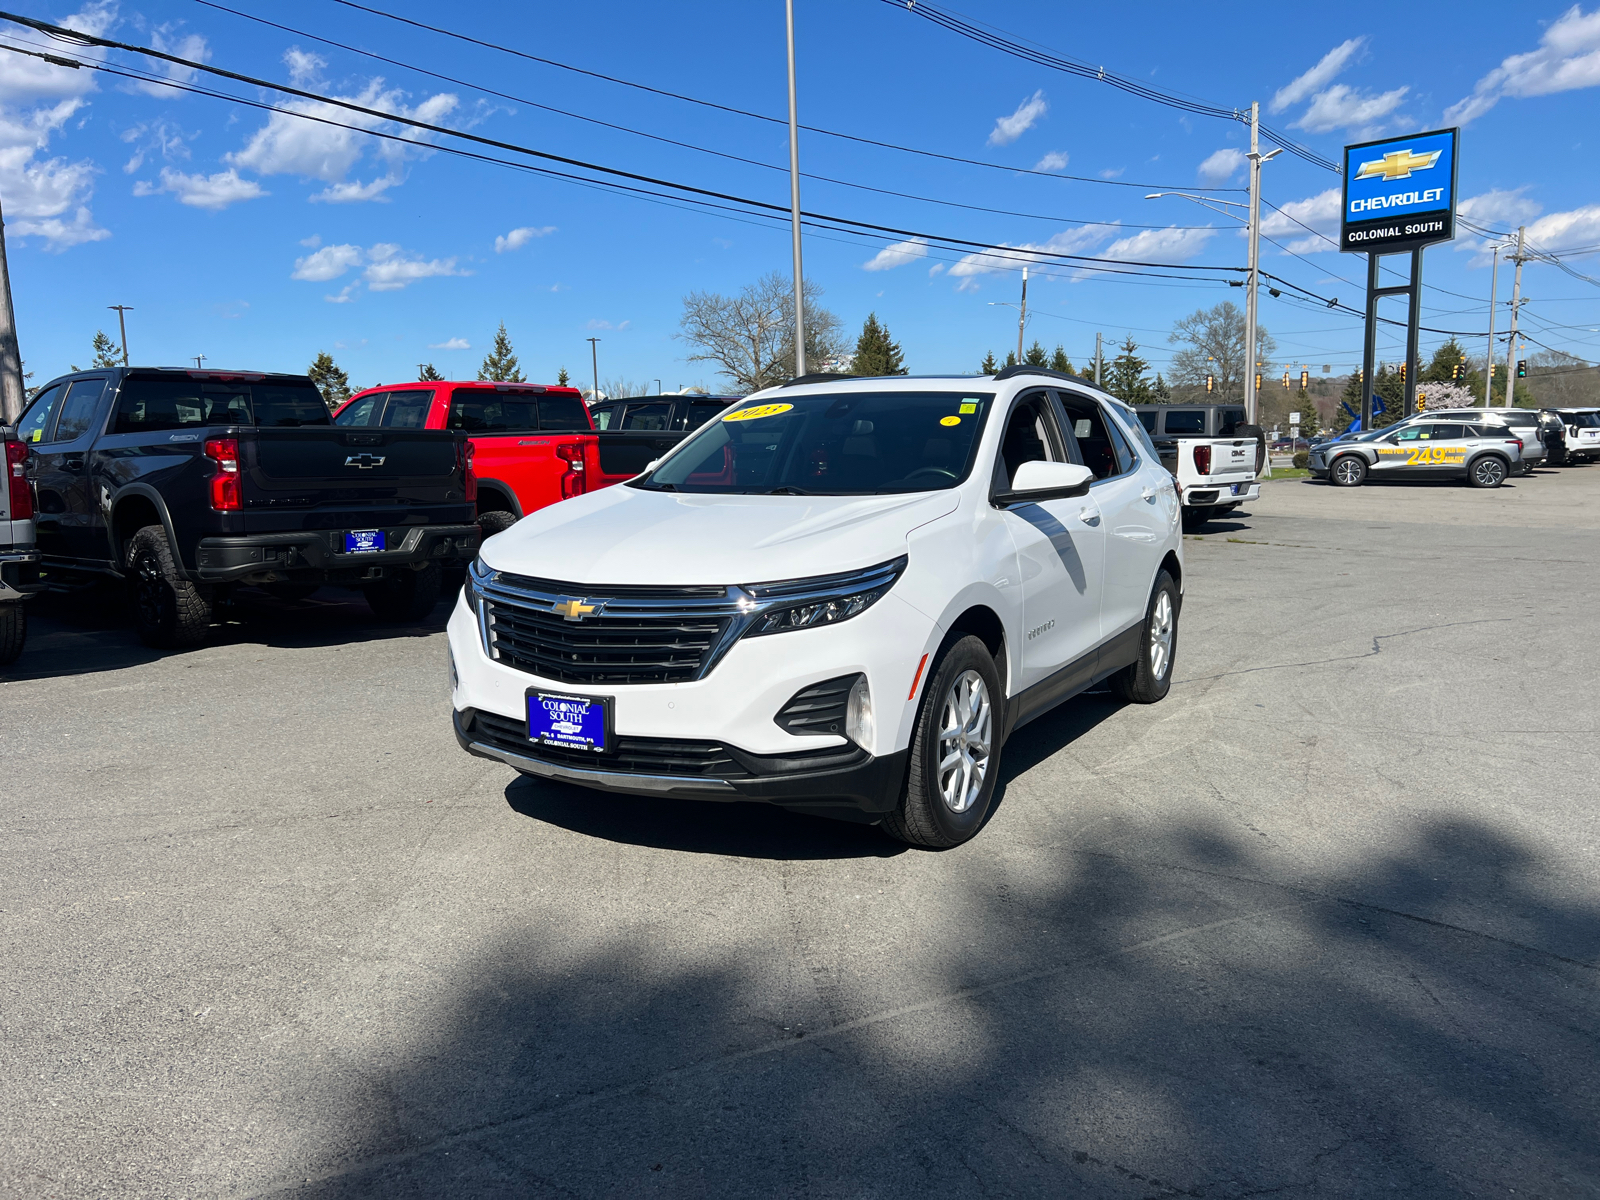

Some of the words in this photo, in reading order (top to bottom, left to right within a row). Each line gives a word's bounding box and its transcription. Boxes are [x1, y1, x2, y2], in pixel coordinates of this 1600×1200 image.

[1350, 188, 1444, 212] CHEVROLET
[1348, 227, 1402, 242] COLONIAL
[1405, 221, 1443, 235] SOUTH
[542, 701, 589, 714] COLONIAL
[550, 711, 582, 723] SOUTH
[553, 723, 580, 731] CHEVROLET
[544, 739, 570, 747] COLONIAL
[570, 742, 588, 751] SOUTH
